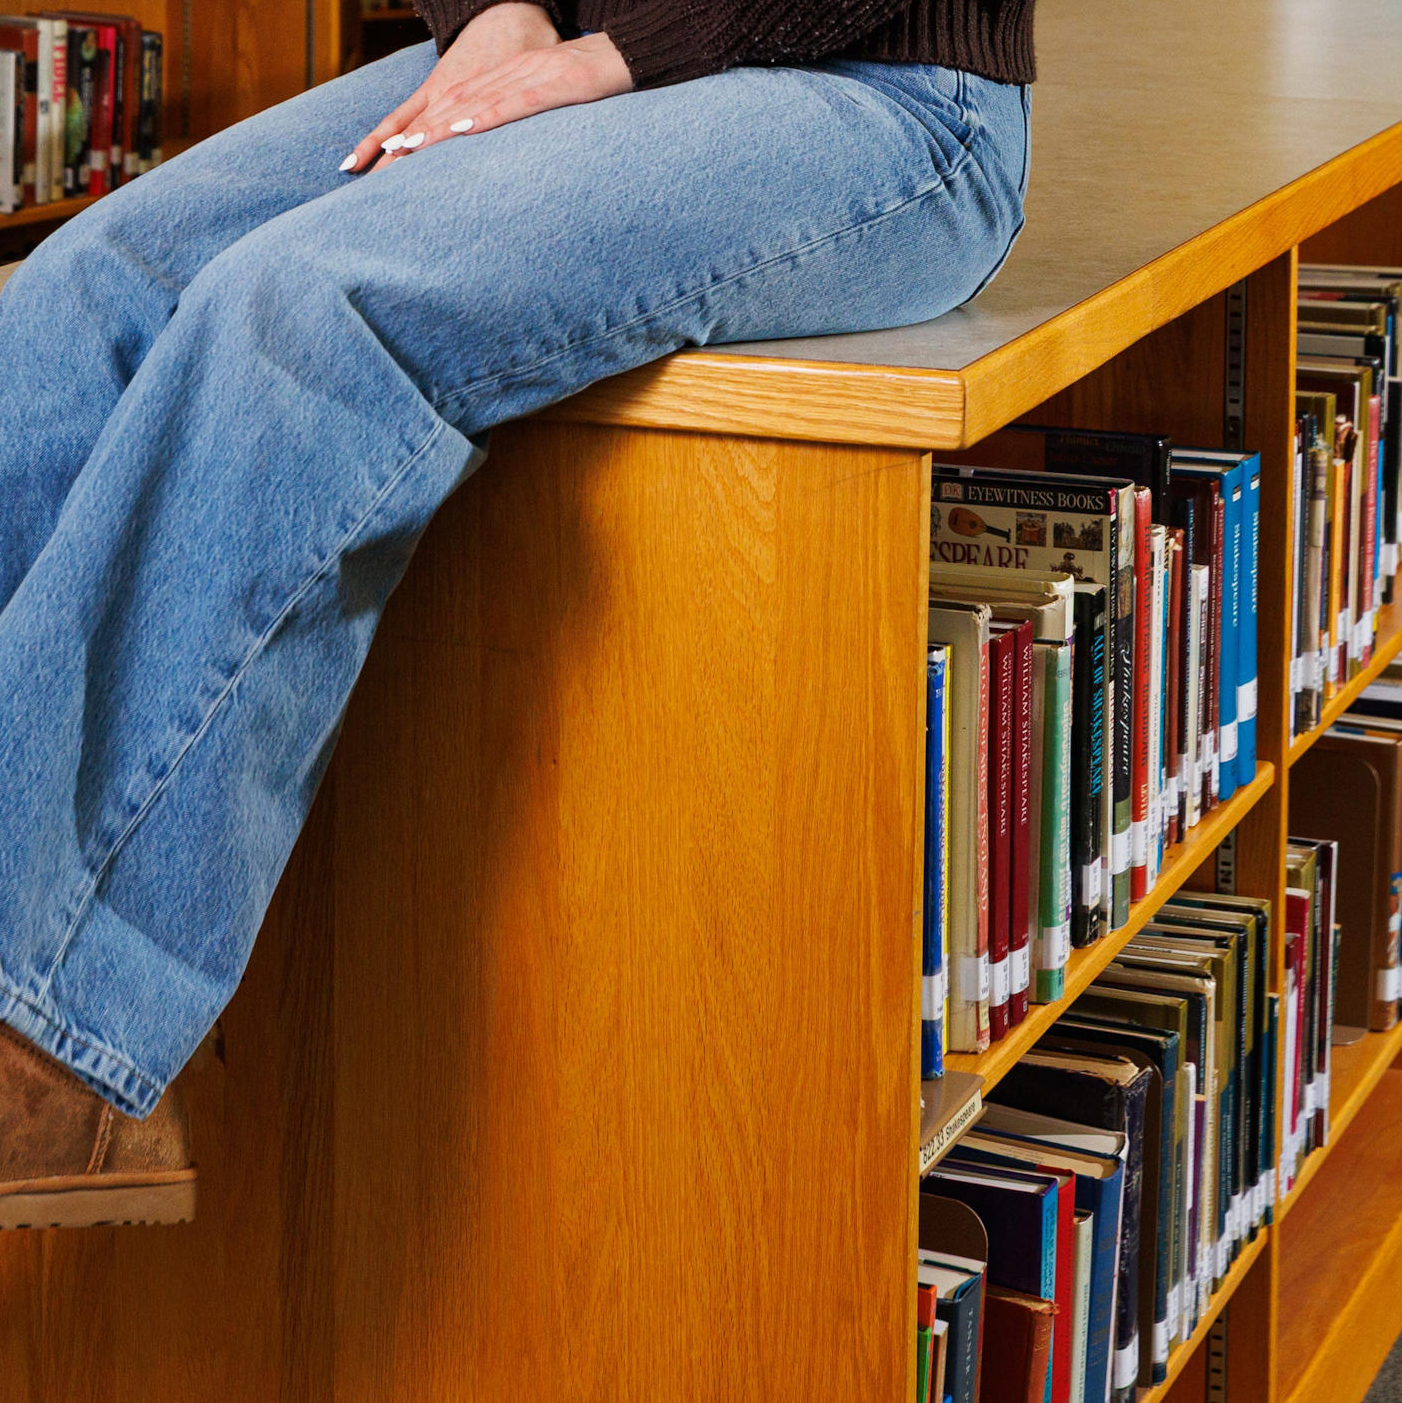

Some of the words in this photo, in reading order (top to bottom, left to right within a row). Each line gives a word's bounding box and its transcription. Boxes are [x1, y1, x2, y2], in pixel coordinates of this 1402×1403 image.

[967, 487, 1055, 507] EYEWITNESS
[1057, 492, 1105, 511] BOOKS
[1232, 523, 1241, 628] Shakespeare
[1093, 634, 1104, 664] ALL
[1143, 561, 1151, 675] SHAKESPEARE
[1021, 645, 1029, 716] WILLIAM
[1093, 667, 1104, 685] OF
[1117, 642, 1133, 776] Shakespeare
[1090, 692, 1104, 799] SHAKESPEARE
[1141, 684, 1149, 767] HANDBOOK
[1000, 730, 1008, 837] SHAKESPEARE
[1020, 721, 1029, 827] SHAKESPEARE
[922, 1129, 945, 1165] 822.33
[945, 1101, 977, 1141] Shakespeare
[965, 1307, 975, 1376] TANNER
